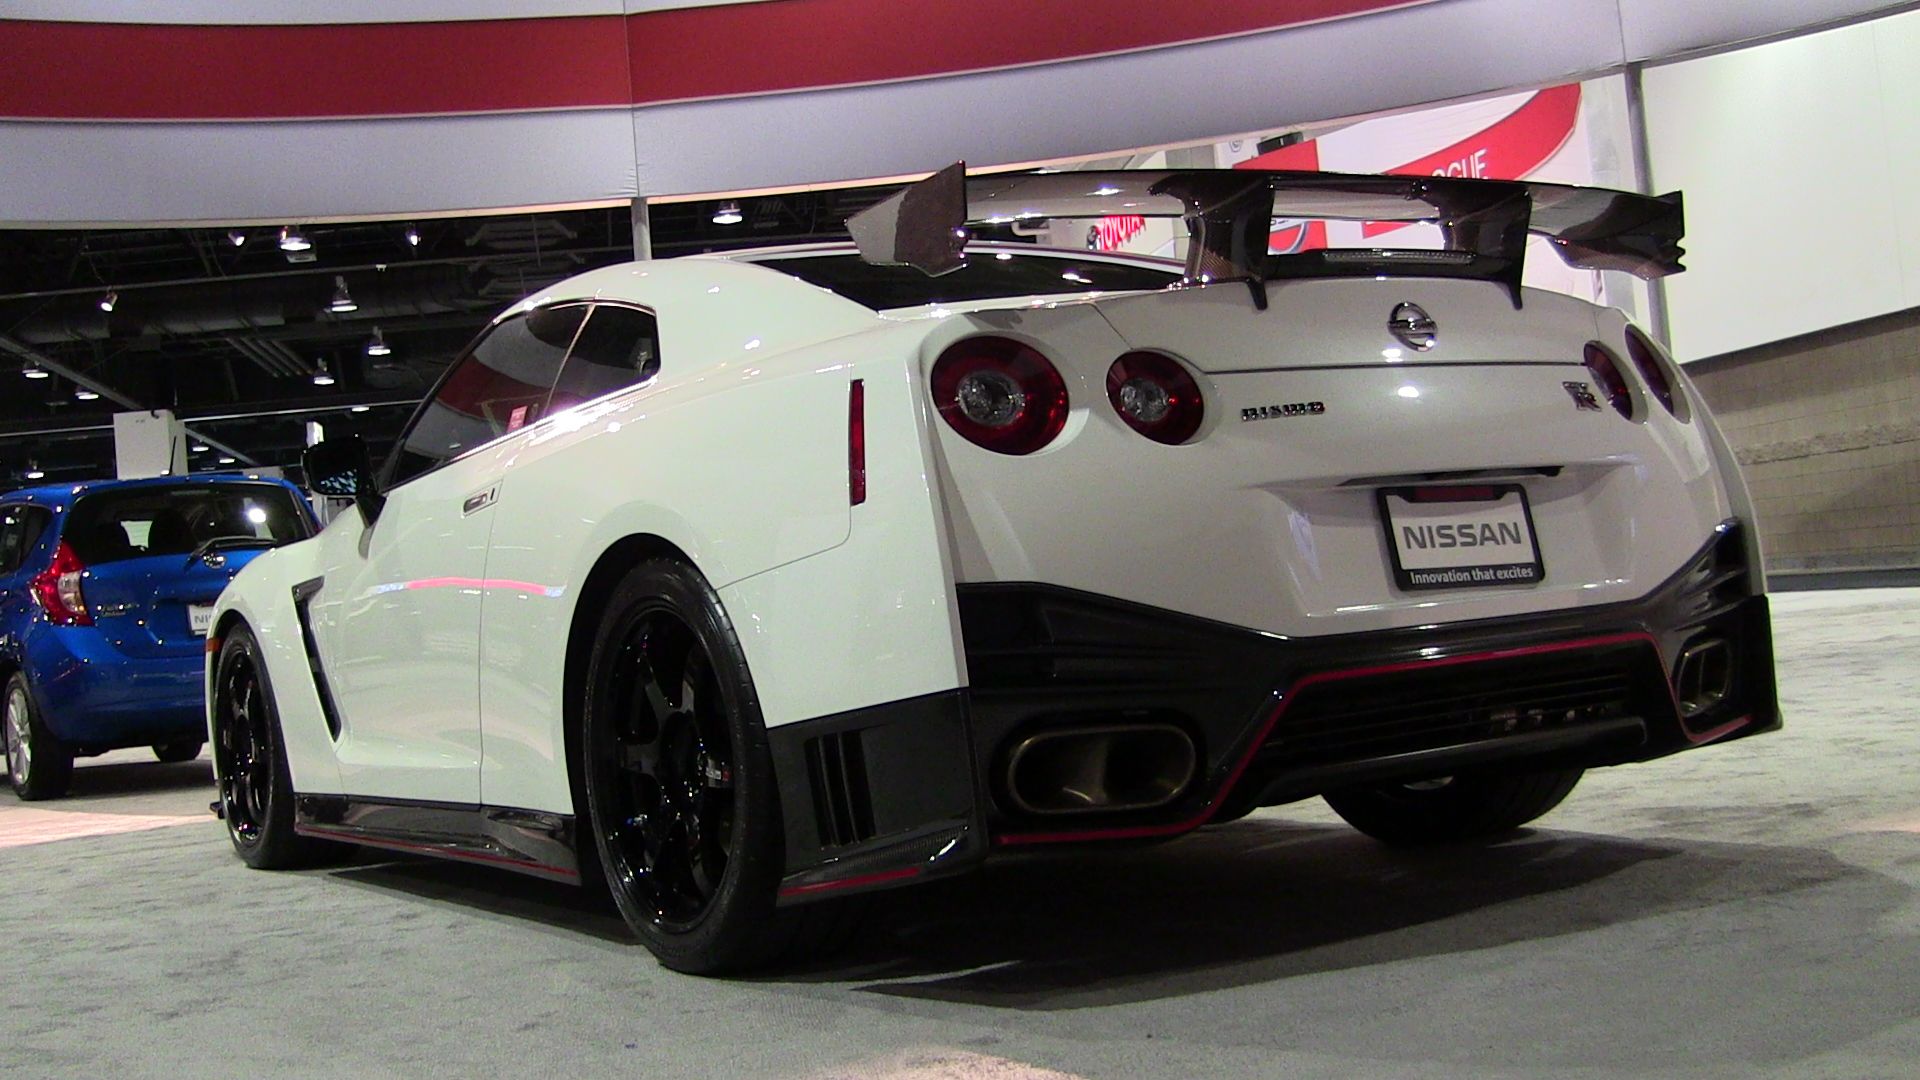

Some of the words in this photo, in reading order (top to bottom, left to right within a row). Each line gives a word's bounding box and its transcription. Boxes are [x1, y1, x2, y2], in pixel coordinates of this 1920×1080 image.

[1431, 148, 1488, 179] GUE
[1099, 216, 1145, 250] TOYOTA
[1402, 522, 1522, 549] NISSAN
[1411, 570, 1471, 585] Innovation
[1472, 568, 1495, 581] that
[1497, 566, 1534, 579] excites
